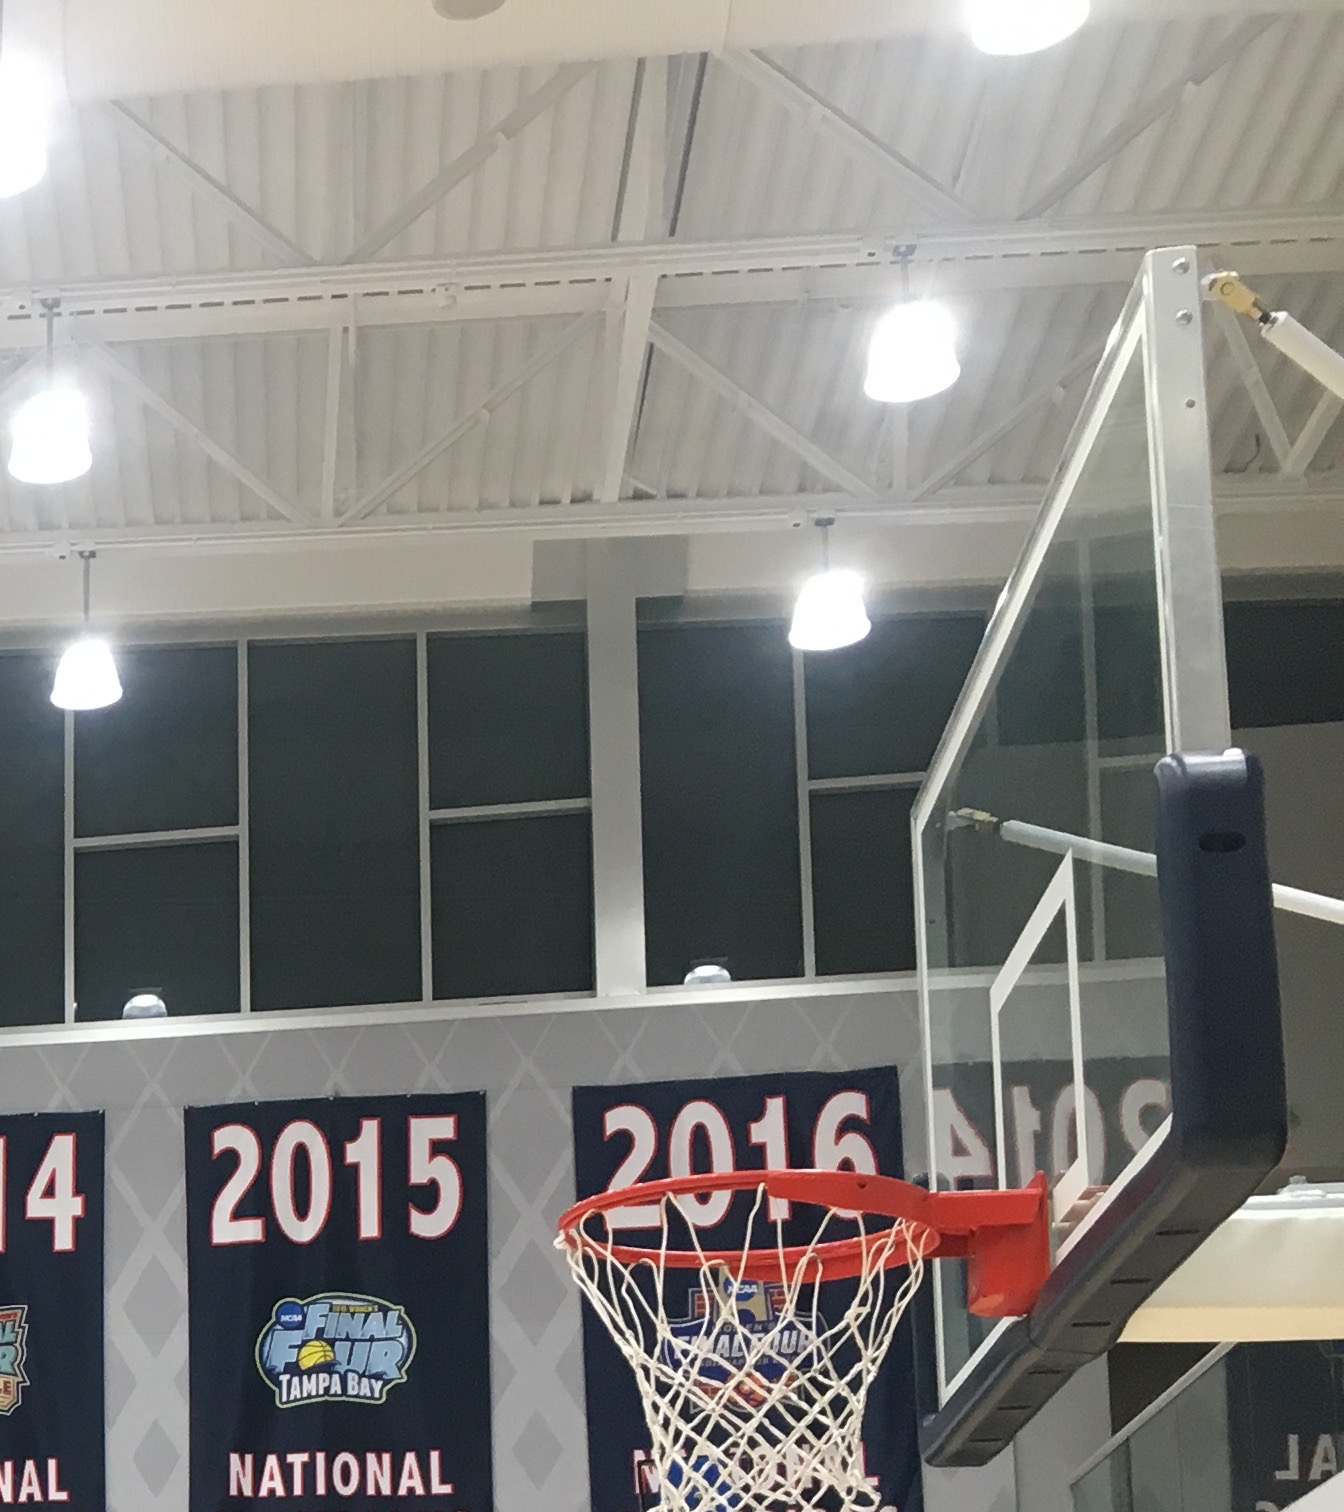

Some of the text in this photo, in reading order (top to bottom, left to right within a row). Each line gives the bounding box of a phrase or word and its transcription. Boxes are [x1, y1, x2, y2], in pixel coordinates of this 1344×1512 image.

[210, 1114, 463, 1246] 2015
[602, 1090, 878, 1229] 2016
[279, 1313, 303, 1323] NCAA
[304, 1303, 404, 1340] FINAL
[265, 1329, 404, 1380] FOUR
[278, 1371, 384, 1403] TAMPA BAY
[229, 1449, 454, 1498] NATIONAL
